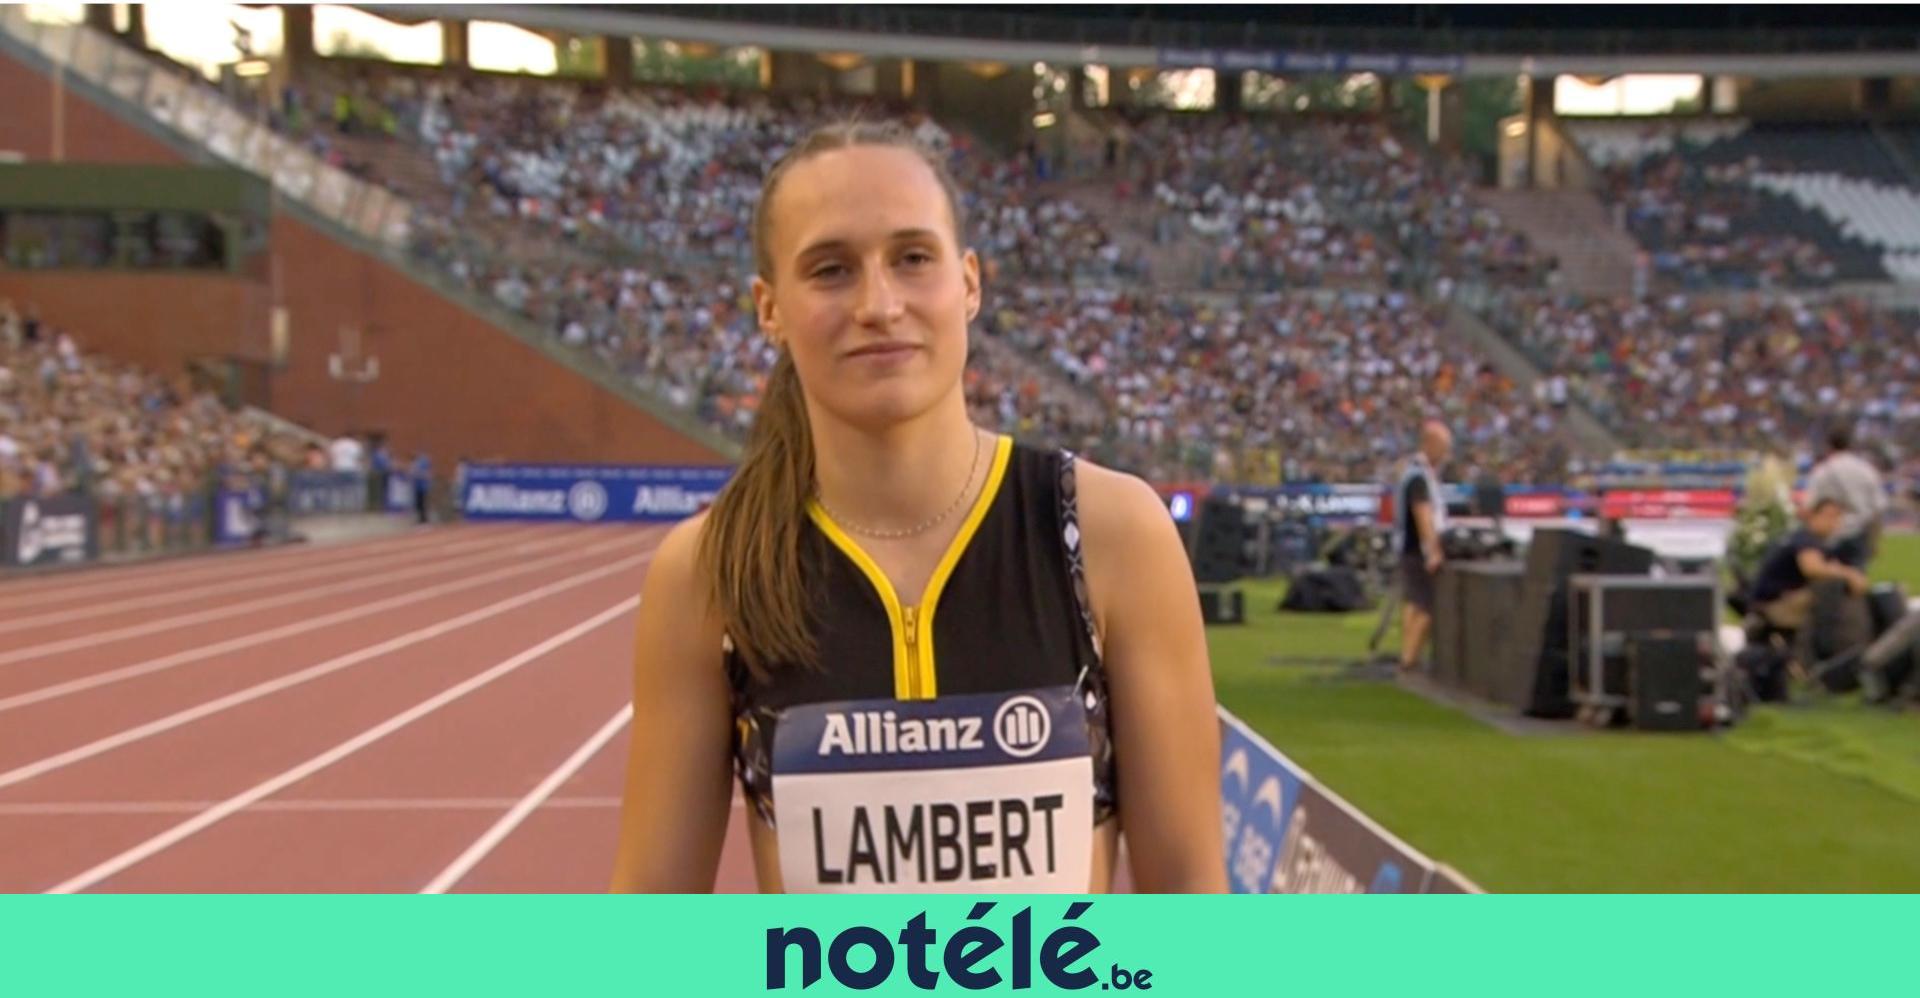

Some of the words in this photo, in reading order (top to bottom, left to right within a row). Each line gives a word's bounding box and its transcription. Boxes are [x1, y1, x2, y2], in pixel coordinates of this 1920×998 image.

[466, 484, 567, 514] Allianz
[818, 711, 983, 756] Allianz
[812, 794, 1063, 885] LAMBERT
